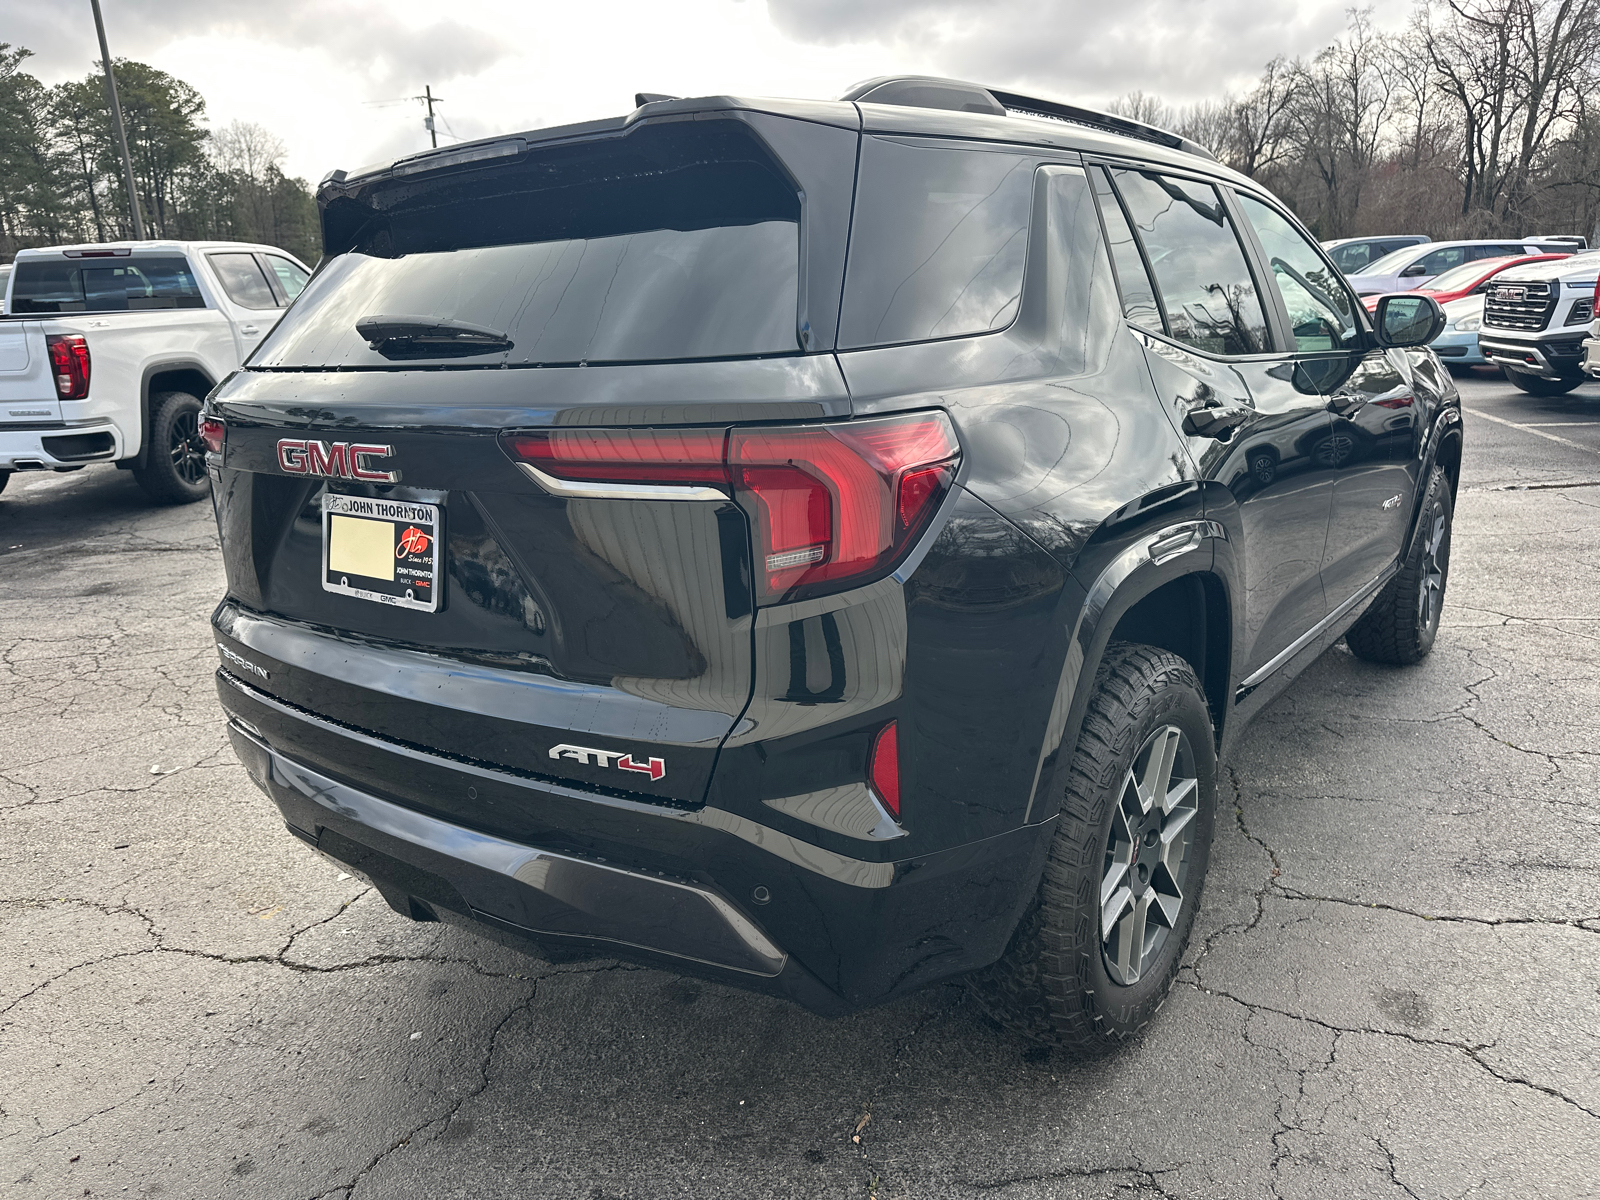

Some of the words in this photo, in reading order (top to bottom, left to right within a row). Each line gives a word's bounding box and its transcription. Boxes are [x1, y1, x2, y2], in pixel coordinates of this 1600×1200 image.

[277, 438, 400, 483] GMC
[349, 500, 373, 514] JOHN
[375, 503, 433, 522] THORNTON
[408, 554, 422, 563] Since
[397, 566, 409, 575] JOHN
[415, 580, 431, 588] GMC
[381, 595, 397, 605] GMC
[548, 743, 666, 781] AT4
